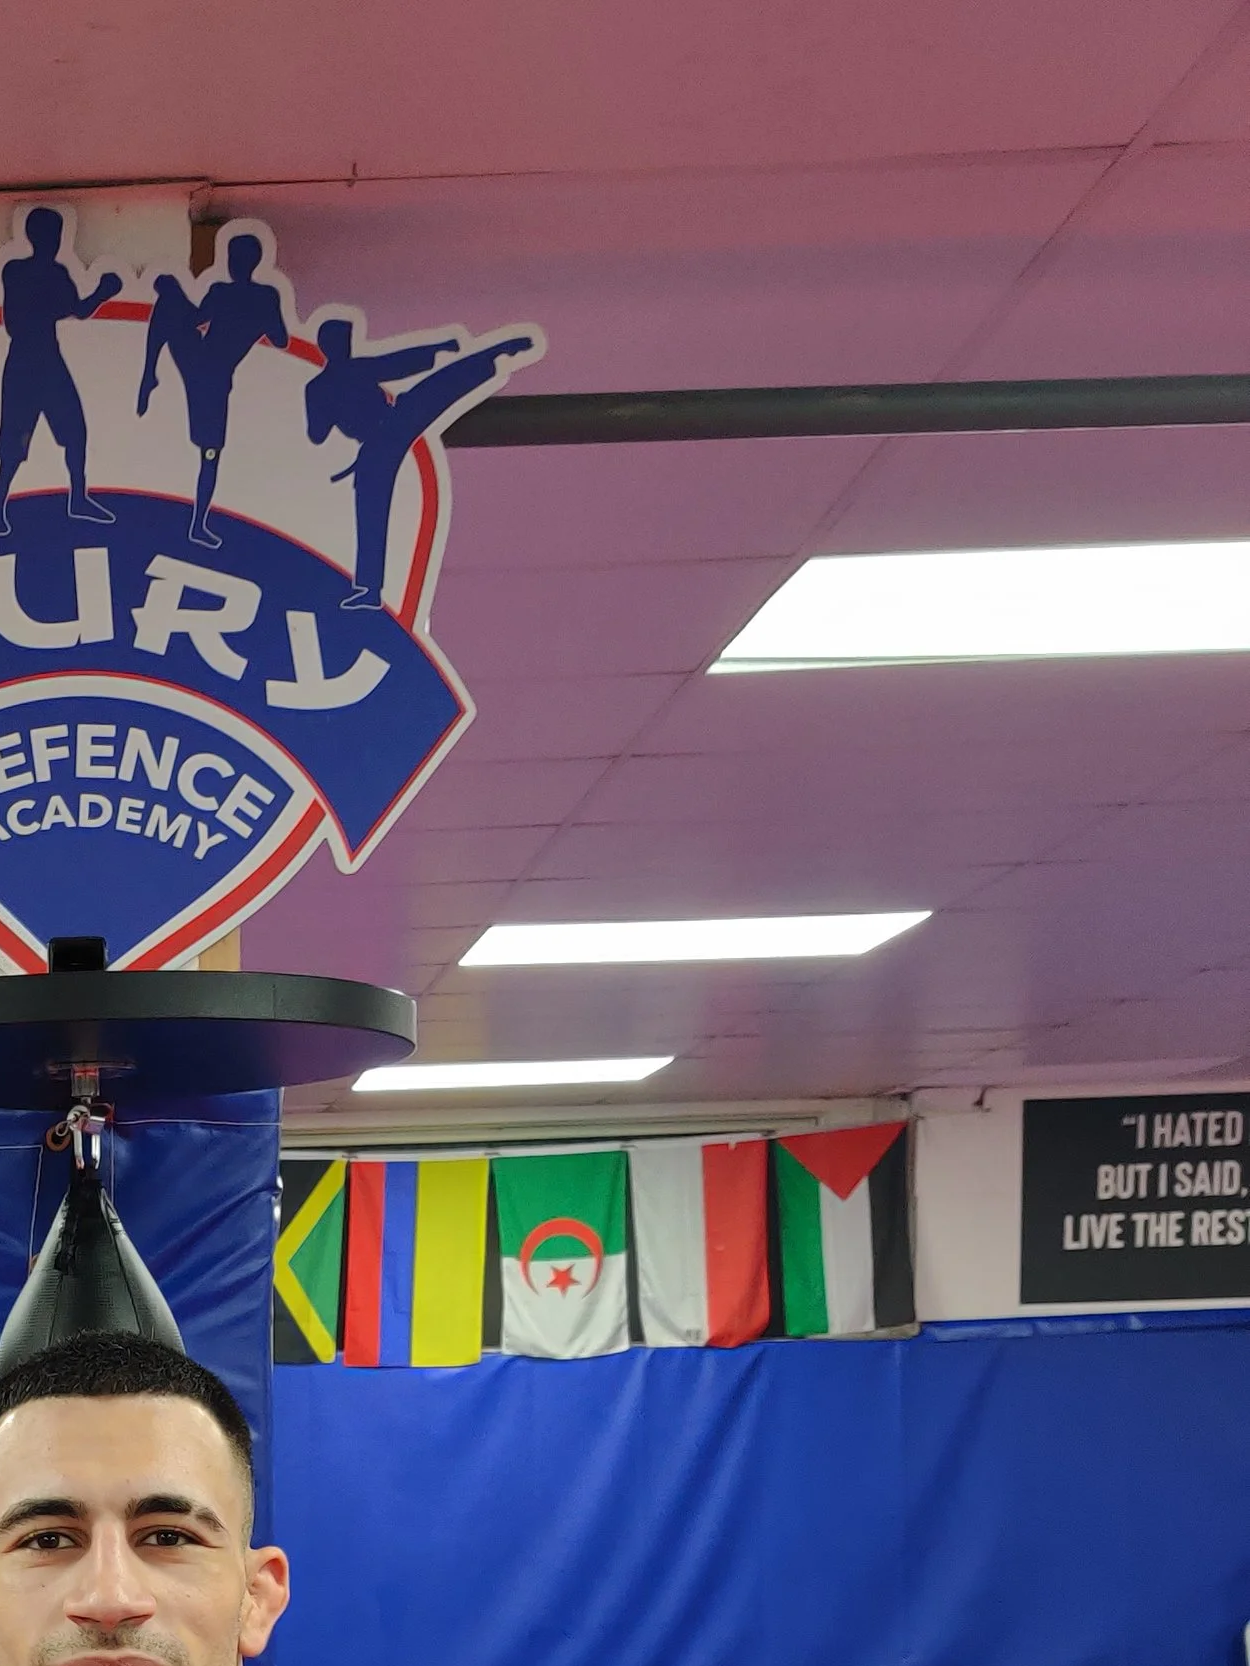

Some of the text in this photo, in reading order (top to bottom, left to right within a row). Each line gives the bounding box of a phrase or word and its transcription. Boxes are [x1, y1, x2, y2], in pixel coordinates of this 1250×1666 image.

[1152, 1110, 1244, 1149] HATED
[1096, 1159, 1249, 1200] BUT I SAID,
[1062, 1212, 1126, 1251] LIVE
[1131, 1210, 1185, 1248] THE
